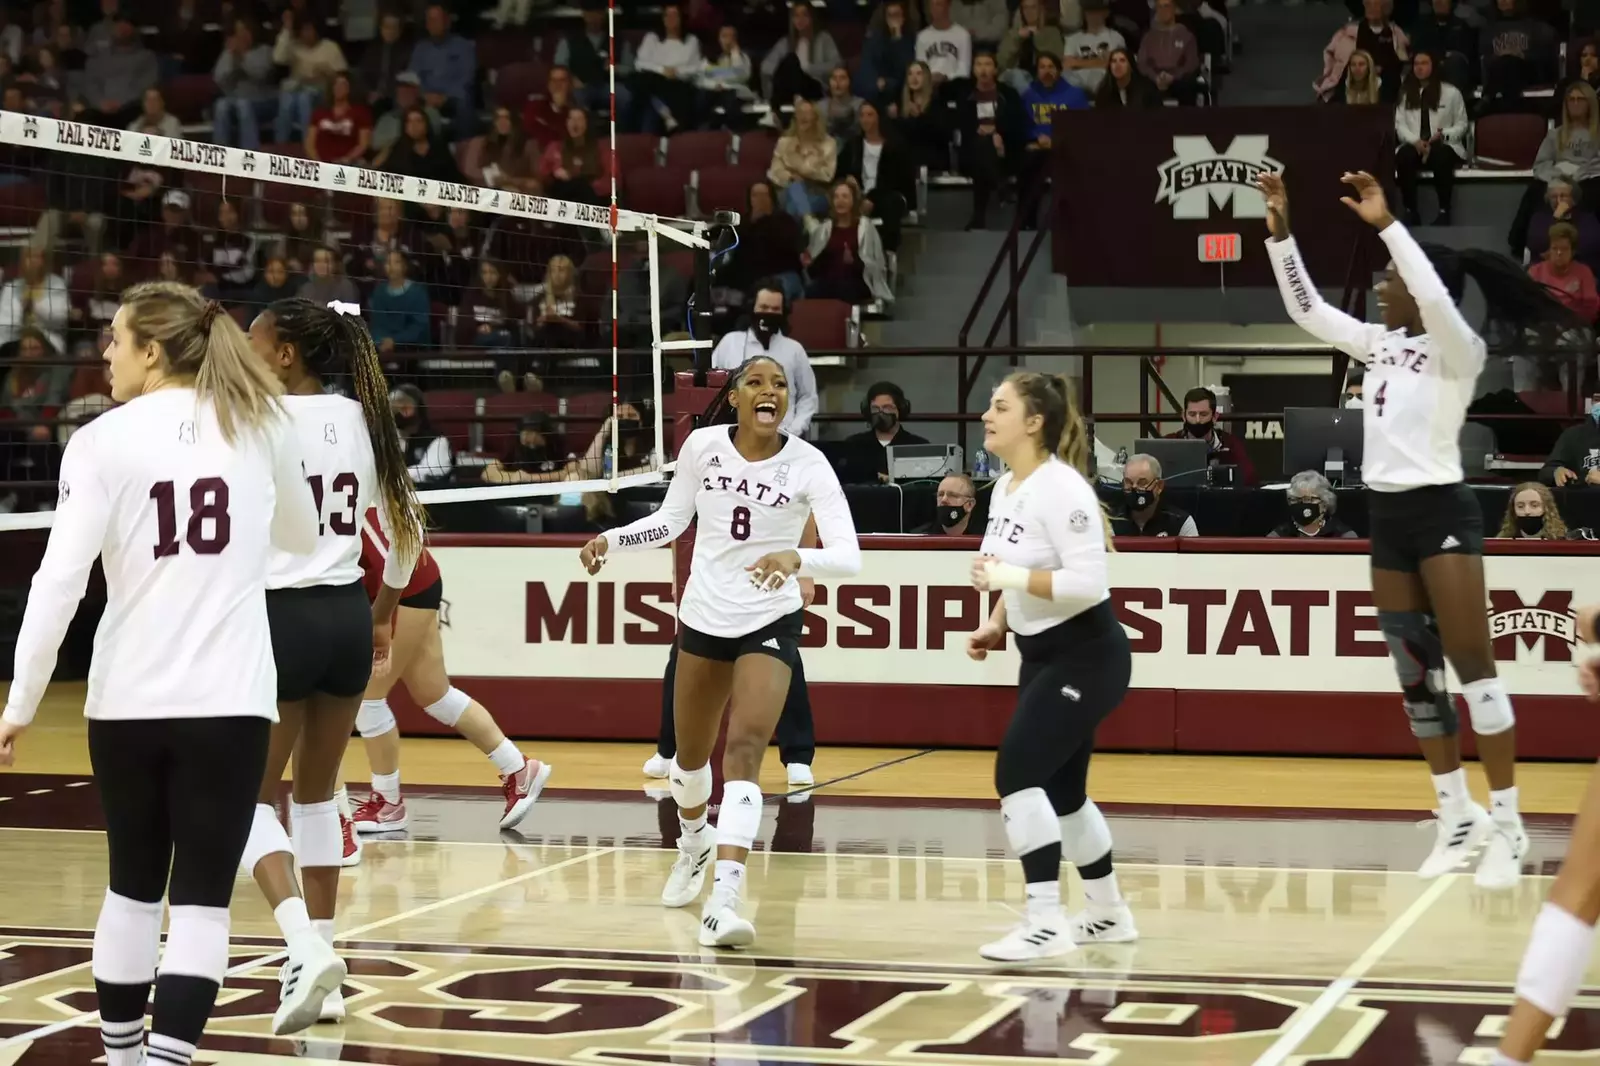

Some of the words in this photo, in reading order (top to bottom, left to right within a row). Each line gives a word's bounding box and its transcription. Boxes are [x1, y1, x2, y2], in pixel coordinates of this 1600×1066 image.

[56, 120, 84, 147] HAIL
[87, 126, 122, 152] STATE
[169, 138, 194, 163] HAIL
[196, 143, 228, 167] STATE
[269, 154, 291, 178] HAIL
[293, 158, 320, 181] STATE
[358, 167, 378, 190] HAIL
[380, 172, 405, 194] STATE
[1181, 161, 1260, 188] STATE
[438, 181, 456, 201] HAIL
[457, 184, 480, 205] STATE
[509, 193, 526, 212] HAIL
[527, 196, 549, 216] STATE
[575, 203, 590, 221] HAIL
[590, 207, 611, 225] STATE
[1205, 233, 1237, 260] EXIT
[1373, 380, 1388, 417] 4
[149, 476, 231, 561] 18
[730, 505, 751, 541] 8
[1108, 587, 1390, 657] STATE
[1493, 611, 1567, 636] STATE
